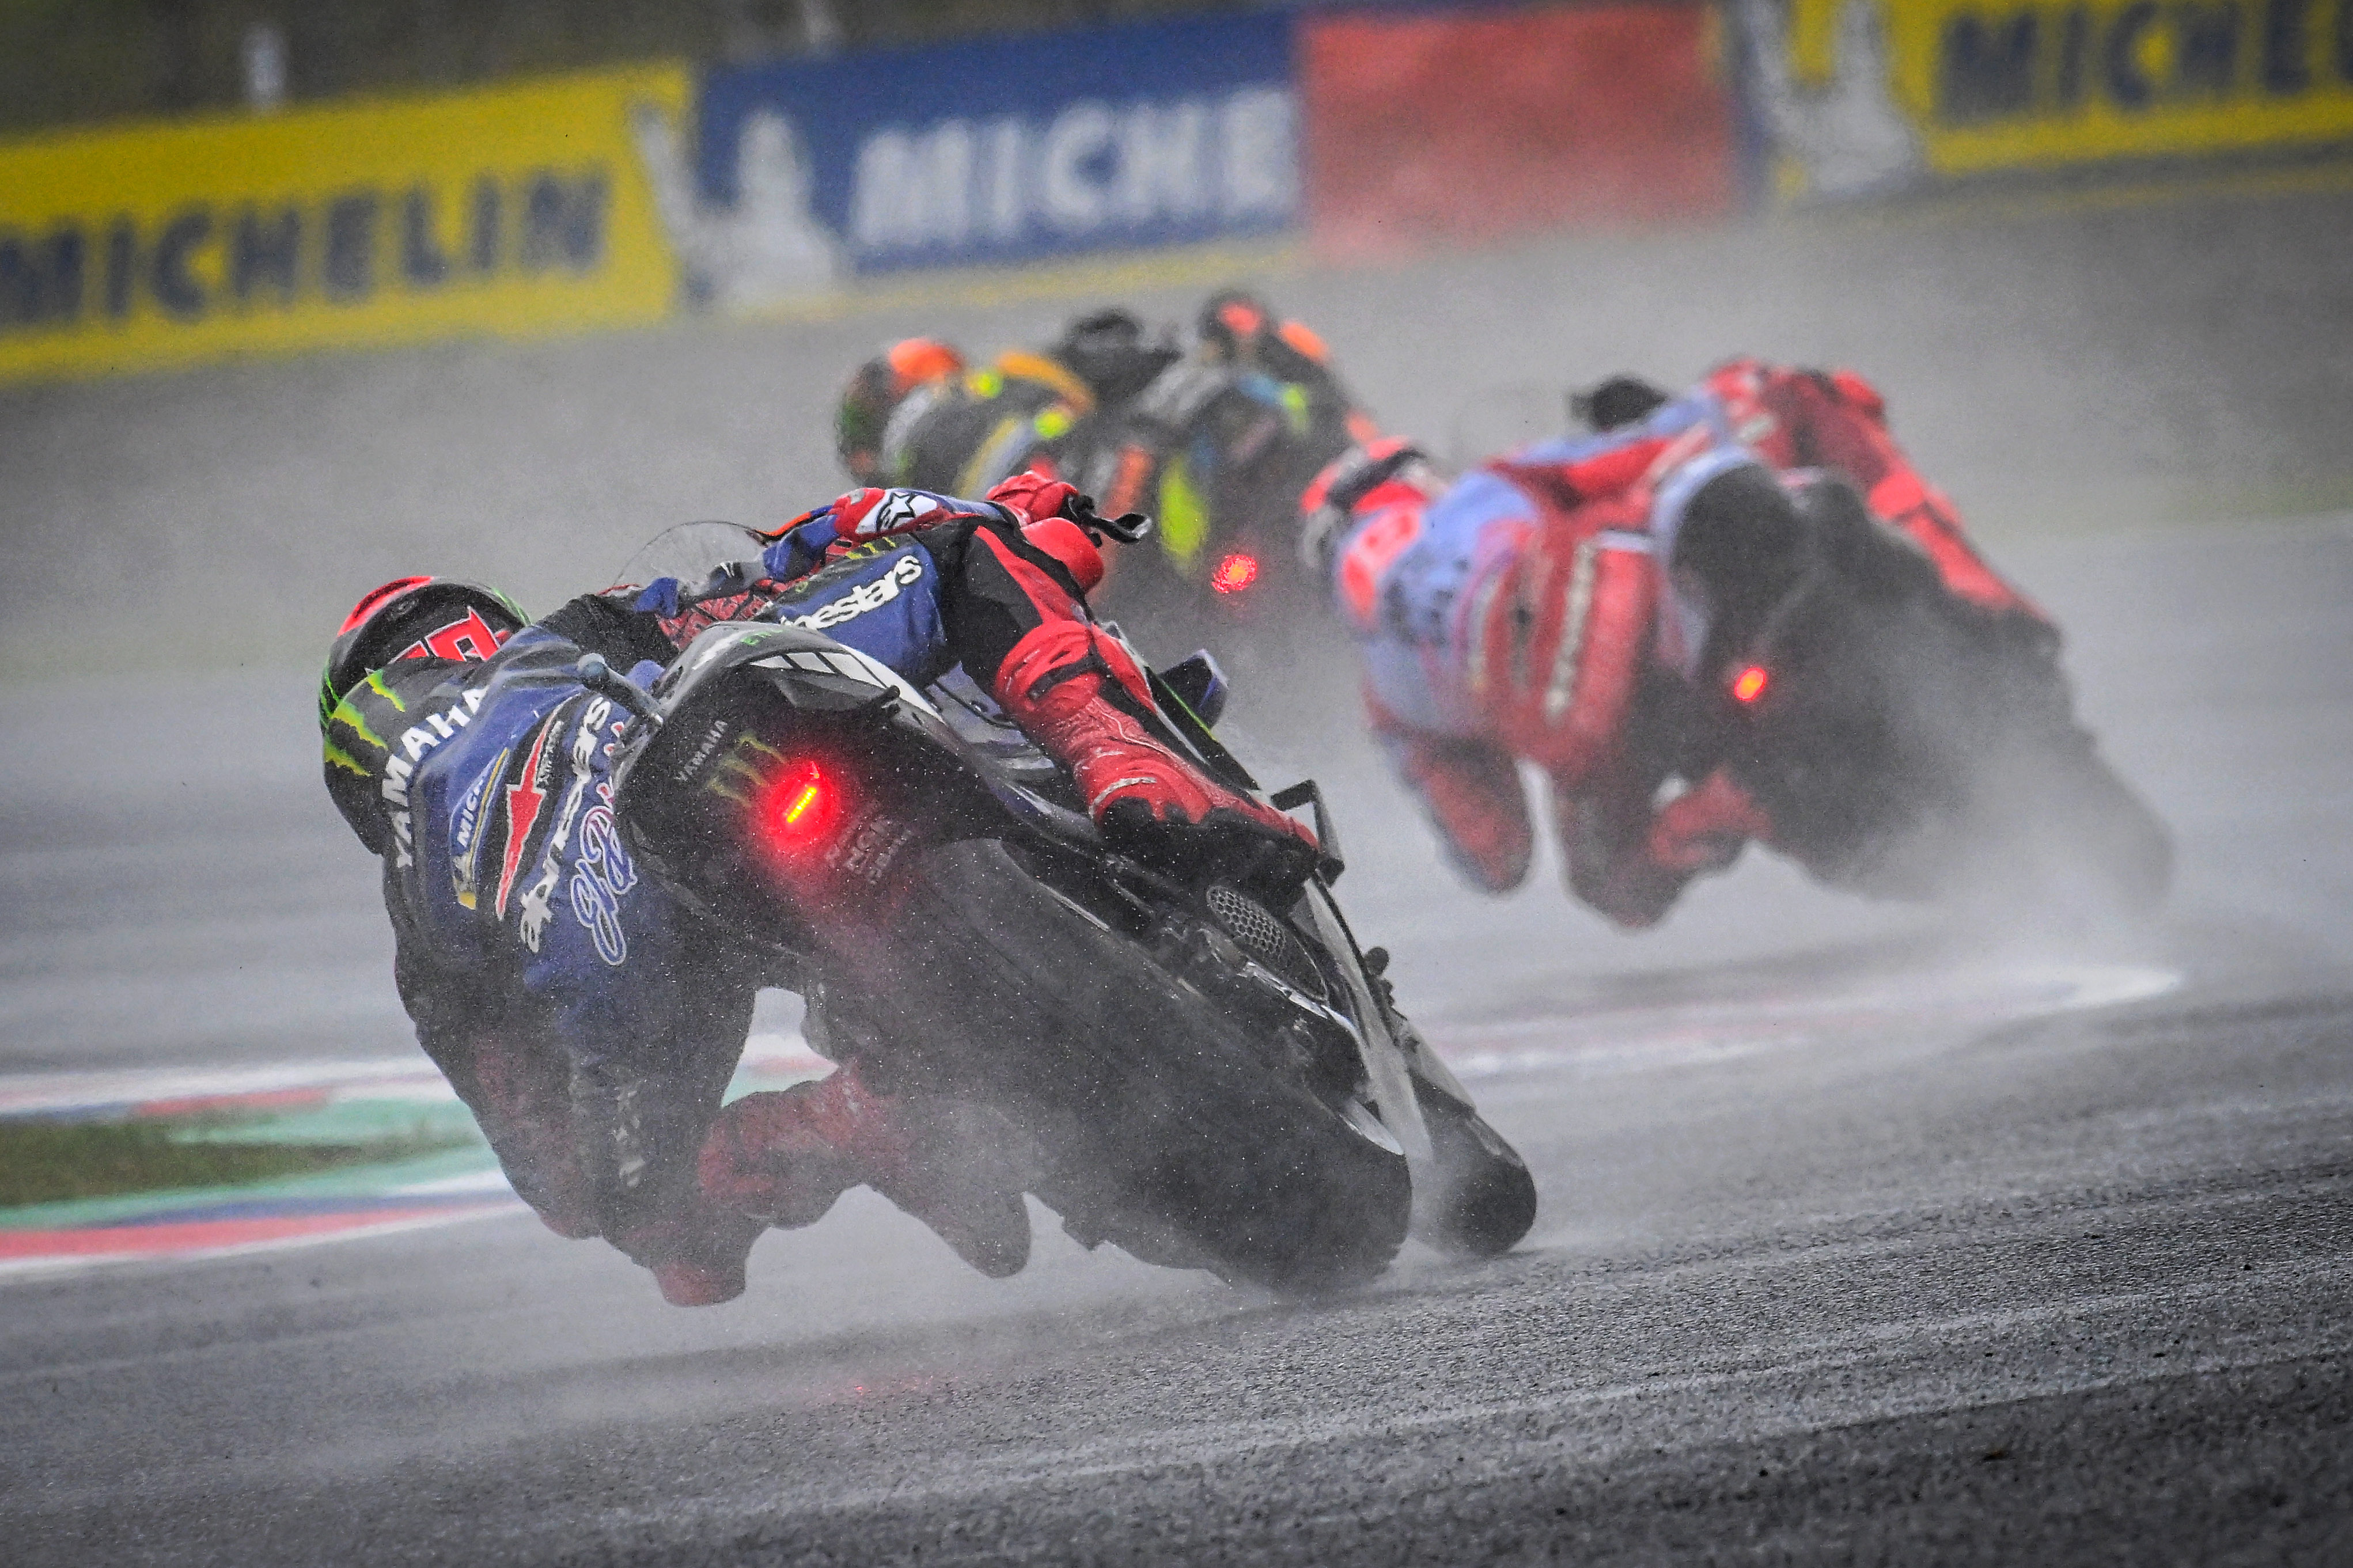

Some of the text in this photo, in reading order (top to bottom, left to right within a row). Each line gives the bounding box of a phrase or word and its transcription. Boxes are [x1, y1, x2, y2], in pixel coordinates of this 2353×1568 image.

[852, 85, 1297, 245] MICHE
[0, 164, 611, 329] MICHELIN
[780, 555, 922, 630] nestars
[382, 685, 489, 867] YAMAHA
[673, 720, 728, 781] YAMAHA
